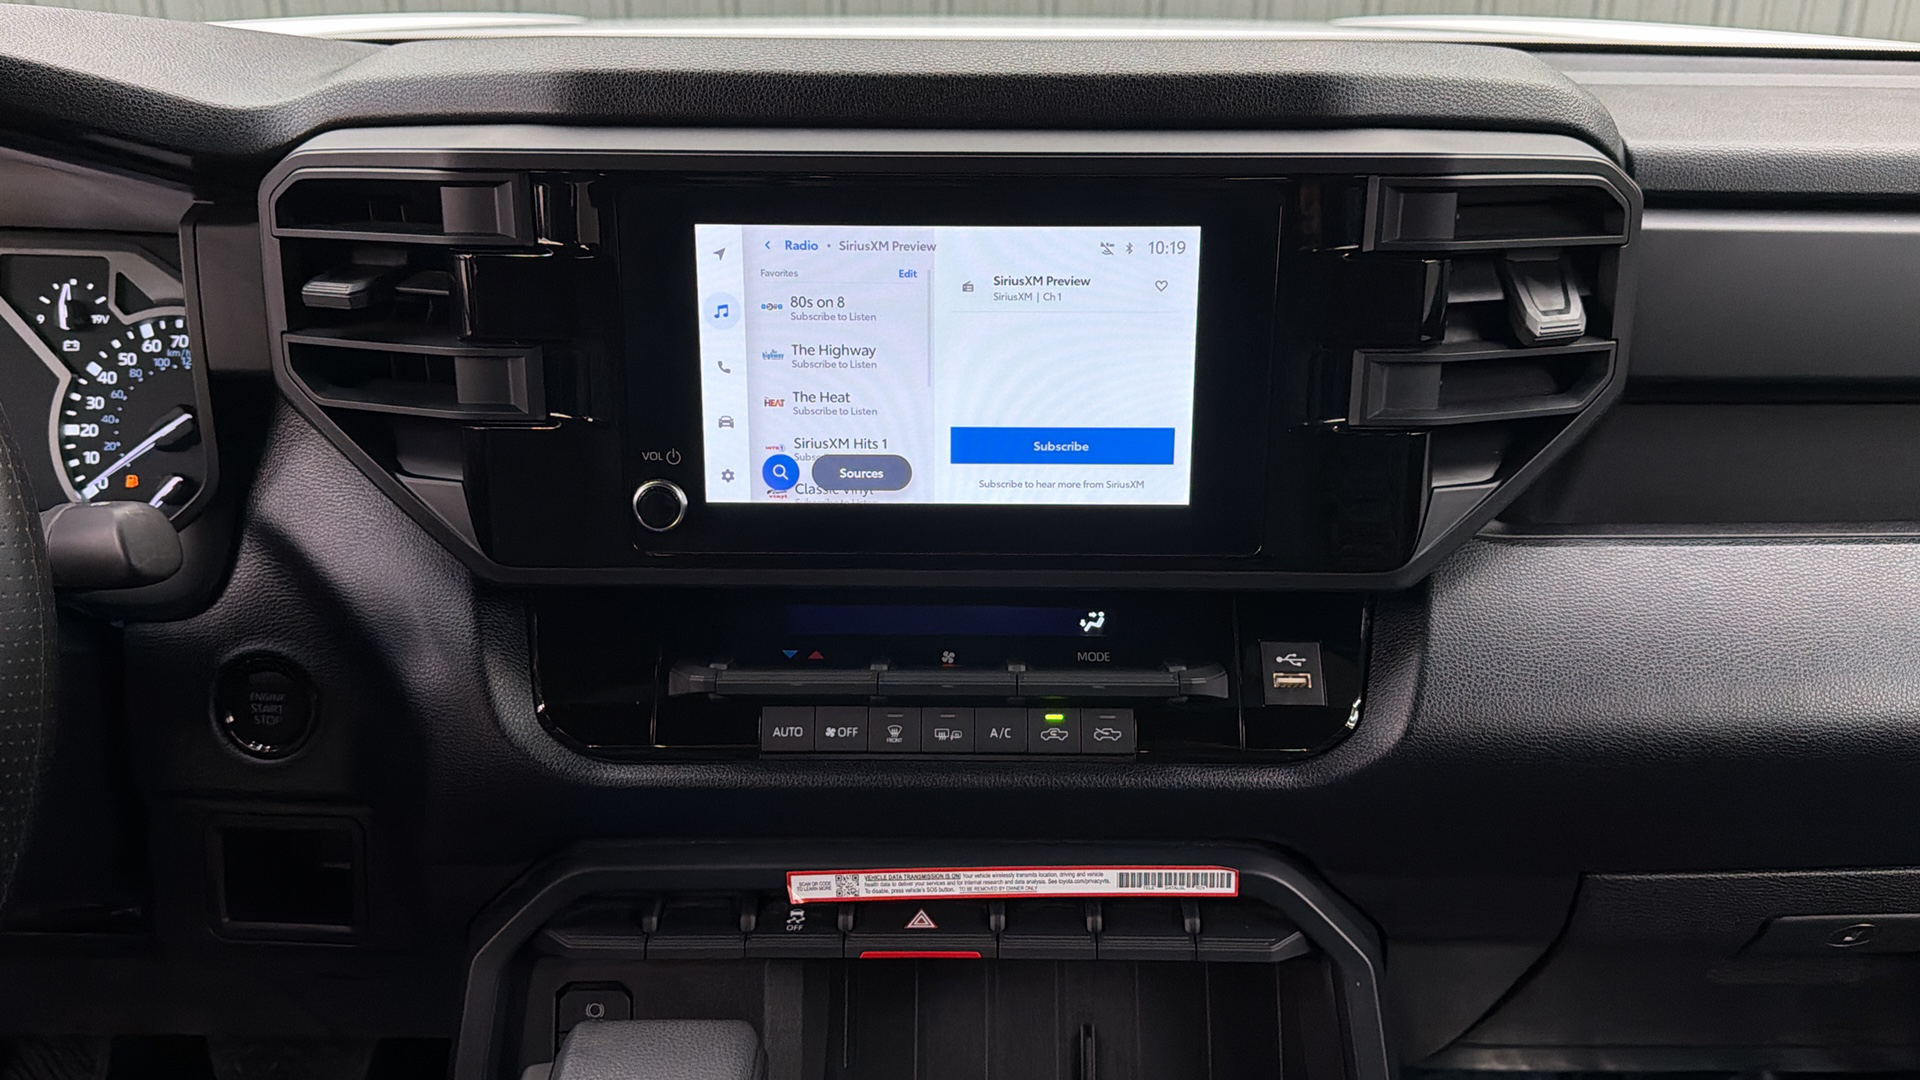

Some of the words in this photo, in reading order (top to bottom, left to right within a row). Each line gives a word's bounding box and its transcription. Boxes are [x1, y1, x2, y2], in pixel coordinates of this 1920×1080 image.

[785, 241, 818, 250] Radio
[839, 241, 889, 251] SiriusXM
[892, 241, 936, 252] Preview
[1148, 241, 1186, 254] 10:19
[760, 269, 798, 278] Favorites
[899, 269, 917, 278] Edit
[993, 276, 1043, 286] SiriusXM
[1046, 276, 1091, 287] Preview
[994, 292, 1032, 301] SiriusXM
[1043, 293, 1055, 301] Ch
[1058, 293, 1062, 301] 1
[791, 296, 813, 308] 80s
[817, 299, 834, 308] on
[837, 296, 845, 308] 8
[36, 314, 45, 324] 9
[791, 312, 836, 321] Subscribe
[849, 312, 876, 321] Listen
[141, 339, 162, 353] 60
[169, 334, 189, 348] 70
[792, 344, 815, 356] The
[819, 344, 876, 359] Highway
[117, 352, 137, 366] 50
[153, 358, 170, 367] 100
[792, 360, 836, 368] Subscribe
[838, 360, 848, 368] to
[850, 360, 877, 368] Listen
[97, 371, 117, 384] 40
[129, 368, 142, 378] 80
[111, 389, 124, 399] 60
[793, 391, 816, 402] The
[820, 392, 851, 403] Heat
[86, 397, 105, 410] 30
[793, 407, 837, 415] Subscribe
[851, 407, 878, 415] Listen
[101, 415, 115, 424] 40
[80, 424, 99, 437] 20
[794, 438, 850, 449] SiriusXM
[854, 438, 878, 449] Hits
[882, 439, 888, 449] 1
[1033, 441, 1089, 452] Subscribe
[82, 452, 100, 464] 10
[642, 452, 663, 460] VOL
[840, 468, 884, 479] Sources
[979, 480, 1023, 488] Subscribe
[1036, 480, 1055, 489] hear
[1083, 480, 1104, 489] from
[1106, 480, 1144, 489] SiriusXM
[1077, 652, 1110, 662] MODE
[250, 692, 286, 702] ENGINE
[251, 703, 283, 713] START
[254, 715, 282, 725] STOP
[773, 727, 803, 737] AUTO
[838, 727, 858, 737] OFF
[990, 727, 1012, 739] A/C
